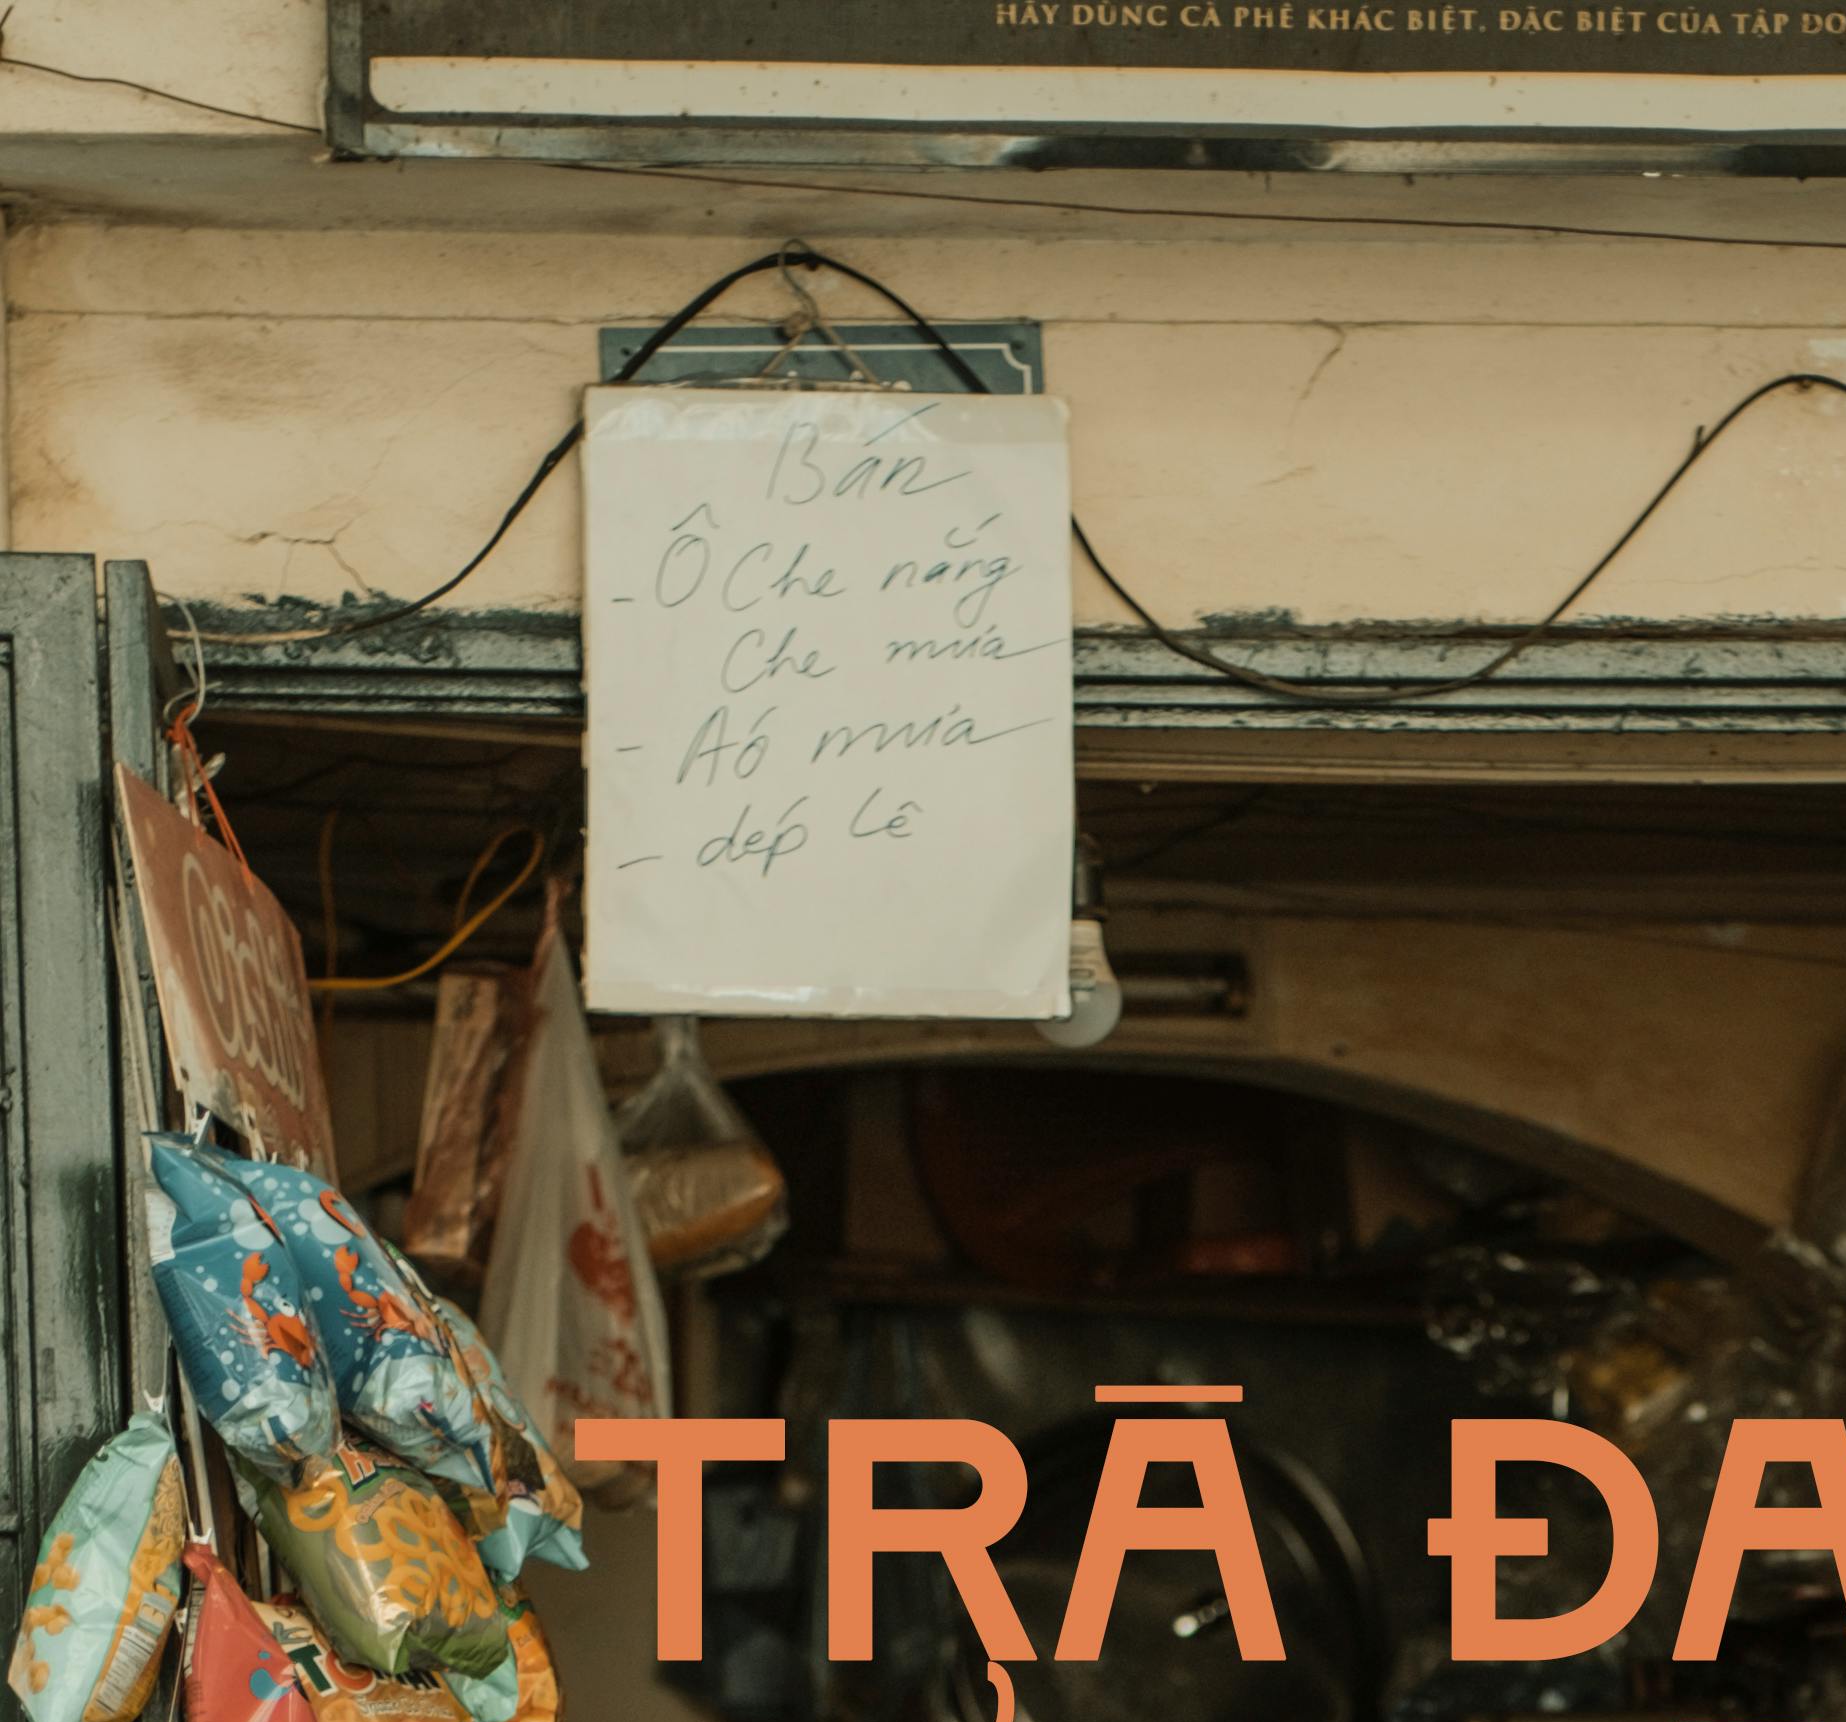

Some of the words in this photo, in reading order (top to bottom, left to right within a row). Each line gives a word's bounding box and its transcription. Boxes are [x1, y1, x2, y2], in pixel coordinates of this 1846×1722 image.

[1234, 2, 1294, 29] PHÊ
[1308, 5, 1394, 31] KHÁC
[1500, 6, 1563, 35] ĐẶC
[1577, 7, 1646, 37] BIỆT
[1657, 6, 1722, 36] CỦA
[1732, 9, 1789, 38] TẬP
[768, 403, 971, 504] Bán
[696, 796, 809, 878] dép
